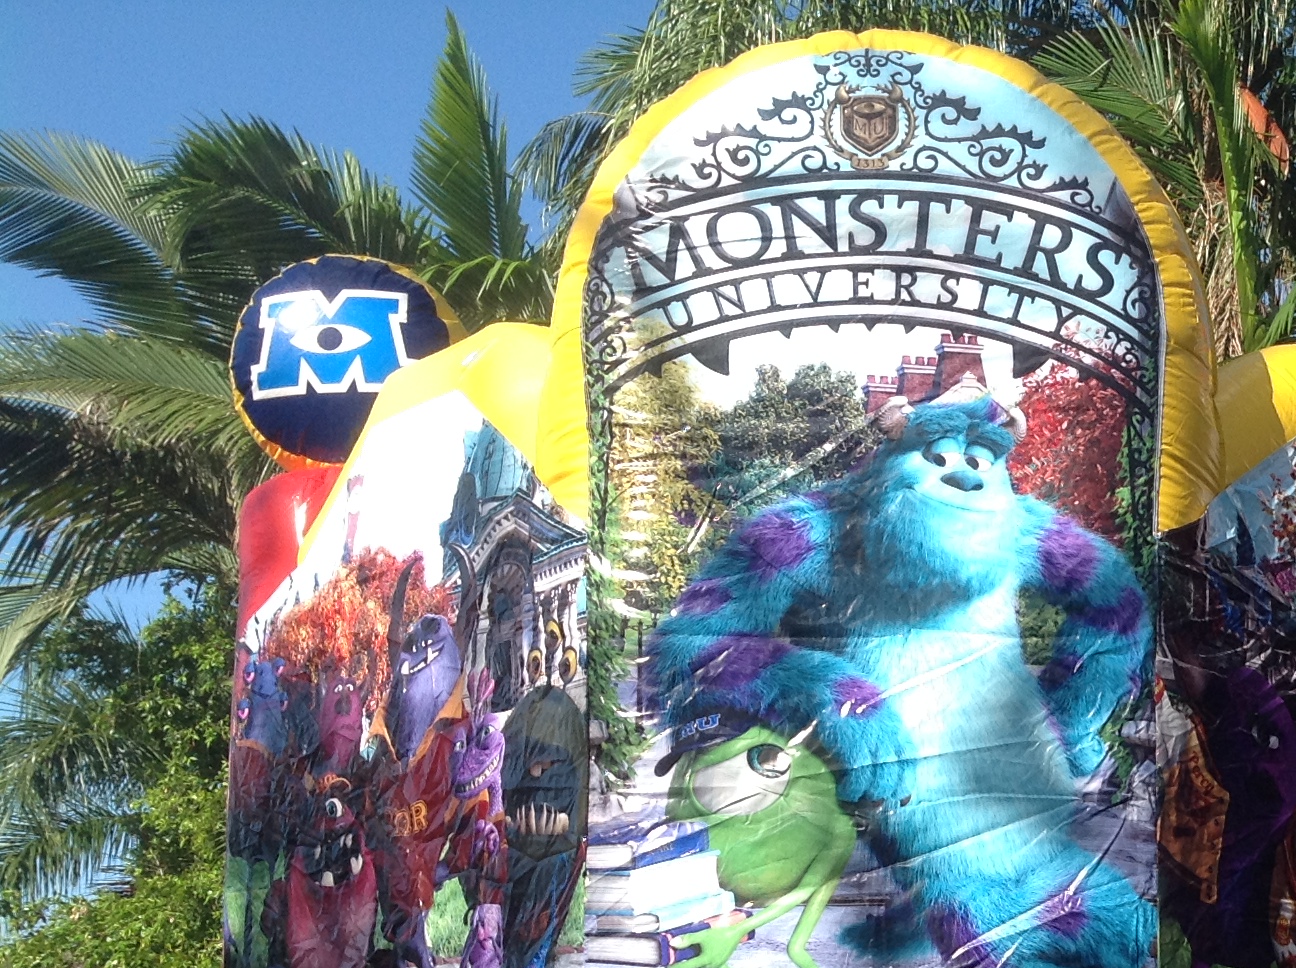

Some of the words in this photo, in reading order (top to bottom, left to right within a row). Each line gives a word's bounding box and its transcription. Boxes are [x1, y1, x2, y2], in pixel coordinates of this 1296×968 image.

[856, 158, 885, 168] 1313
[620, 192, 1126, 300] MONSTERS
[656, 264, 1086, 338] UNIVERSITY
